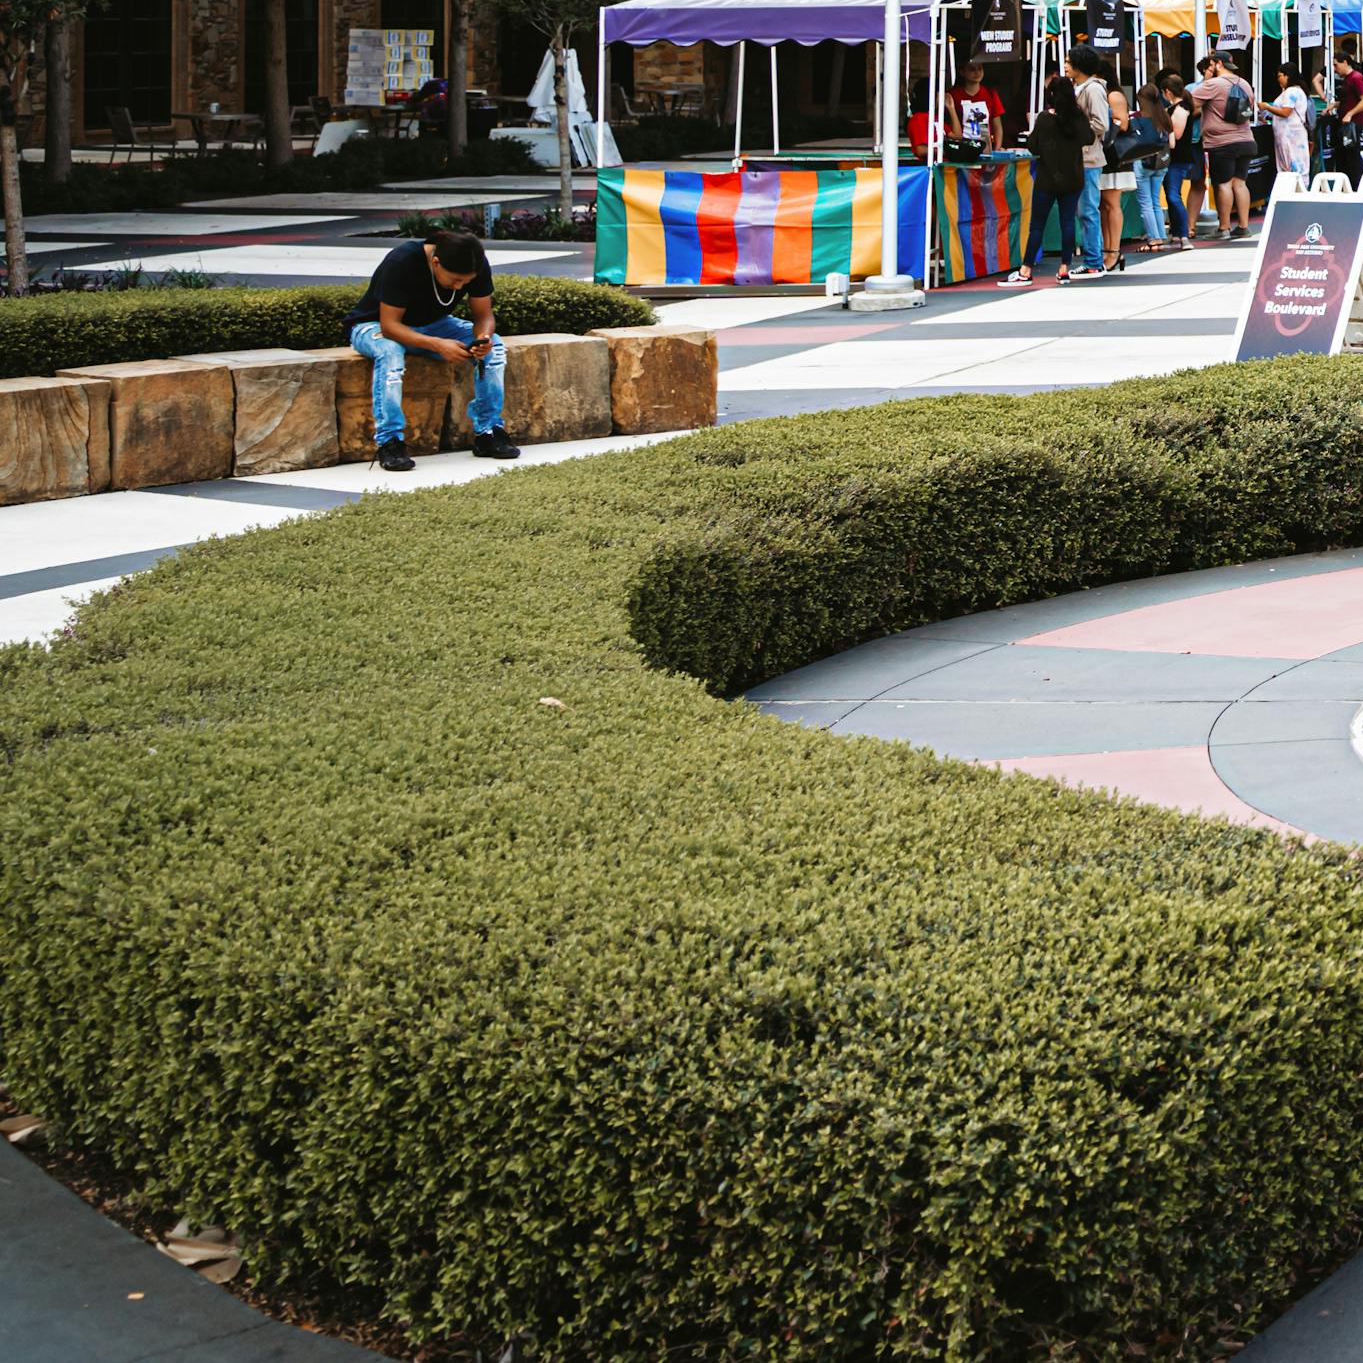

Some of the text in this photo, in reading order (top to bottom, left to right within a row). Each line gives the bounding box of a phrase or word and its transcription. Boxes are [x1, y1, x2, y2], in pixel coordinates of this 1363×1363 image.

[1280, 266, 1329, 280] Student
[1274, 284, 1325, 298] Services
[1264, 301, 1327, 315] Boulevard
